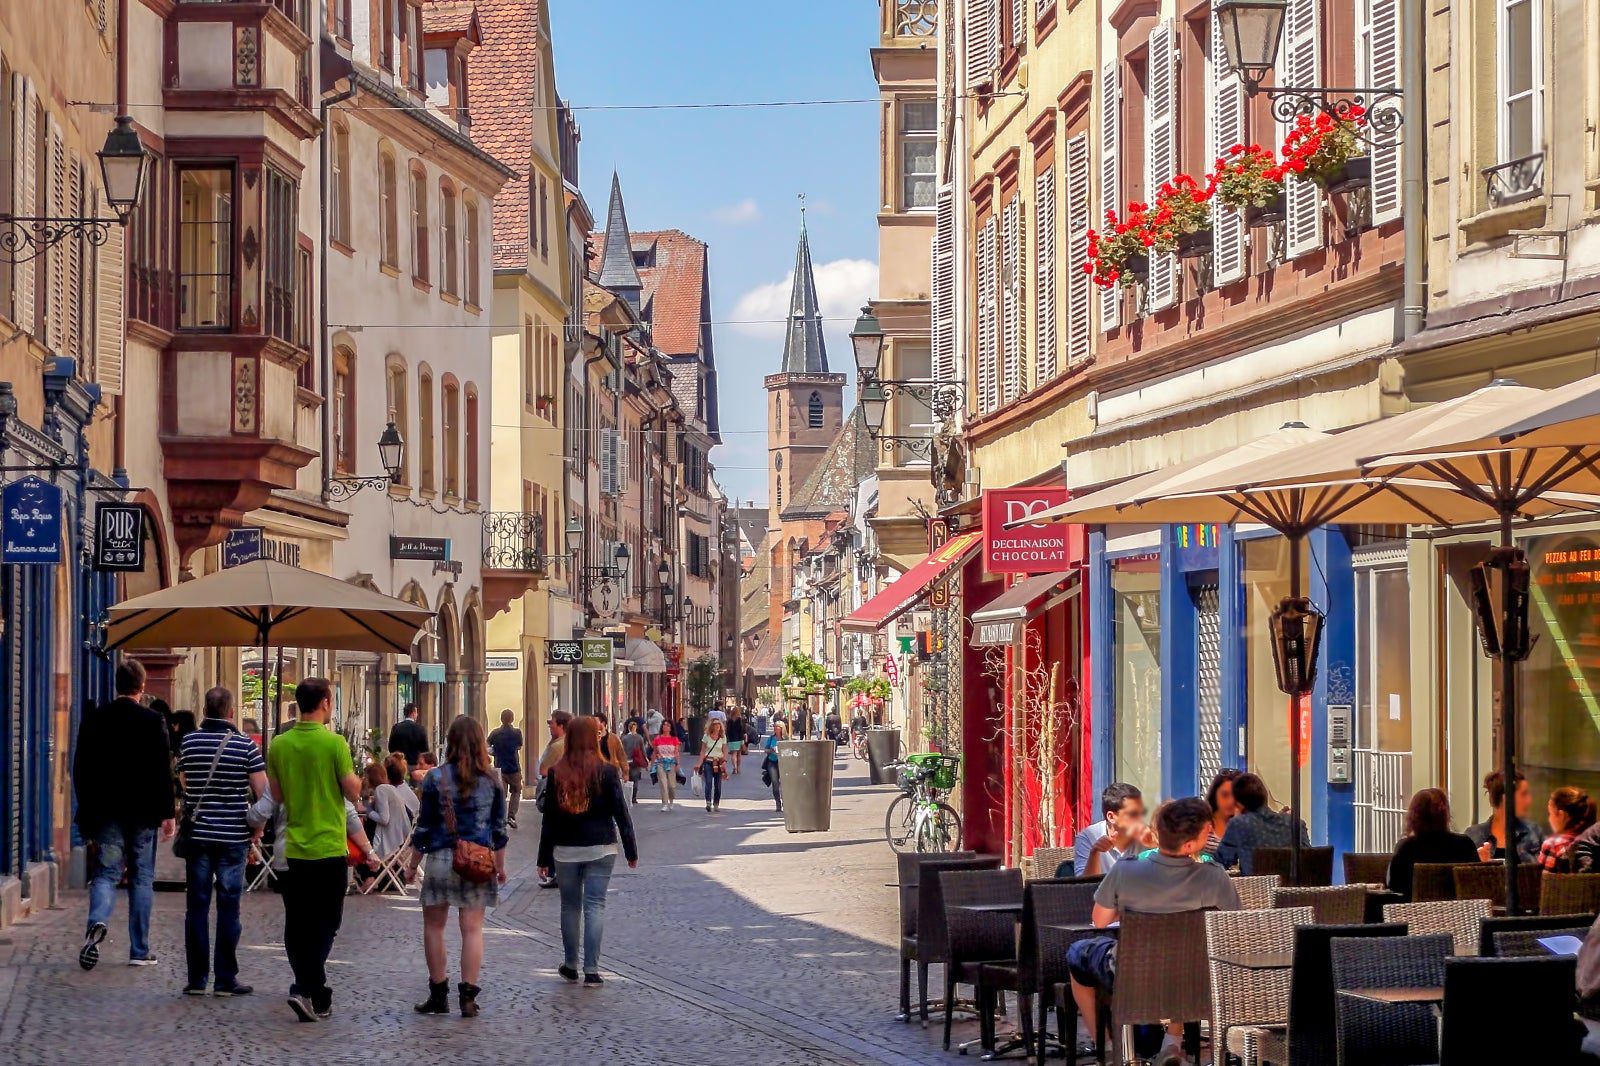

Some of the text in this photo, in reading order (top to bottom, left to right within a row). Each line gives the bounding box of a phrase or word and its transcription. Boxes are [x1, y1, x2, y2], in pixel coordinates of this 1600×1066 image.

[1003, 499, 1049, 528] DC
[106, 511, 133, 539] PUR
[992, 538, 1064, 549] DECLINAISON
[992, 551, 1064, 561] CHOCOLAT
[1546, 552, 1567, 563] PIZZAS
